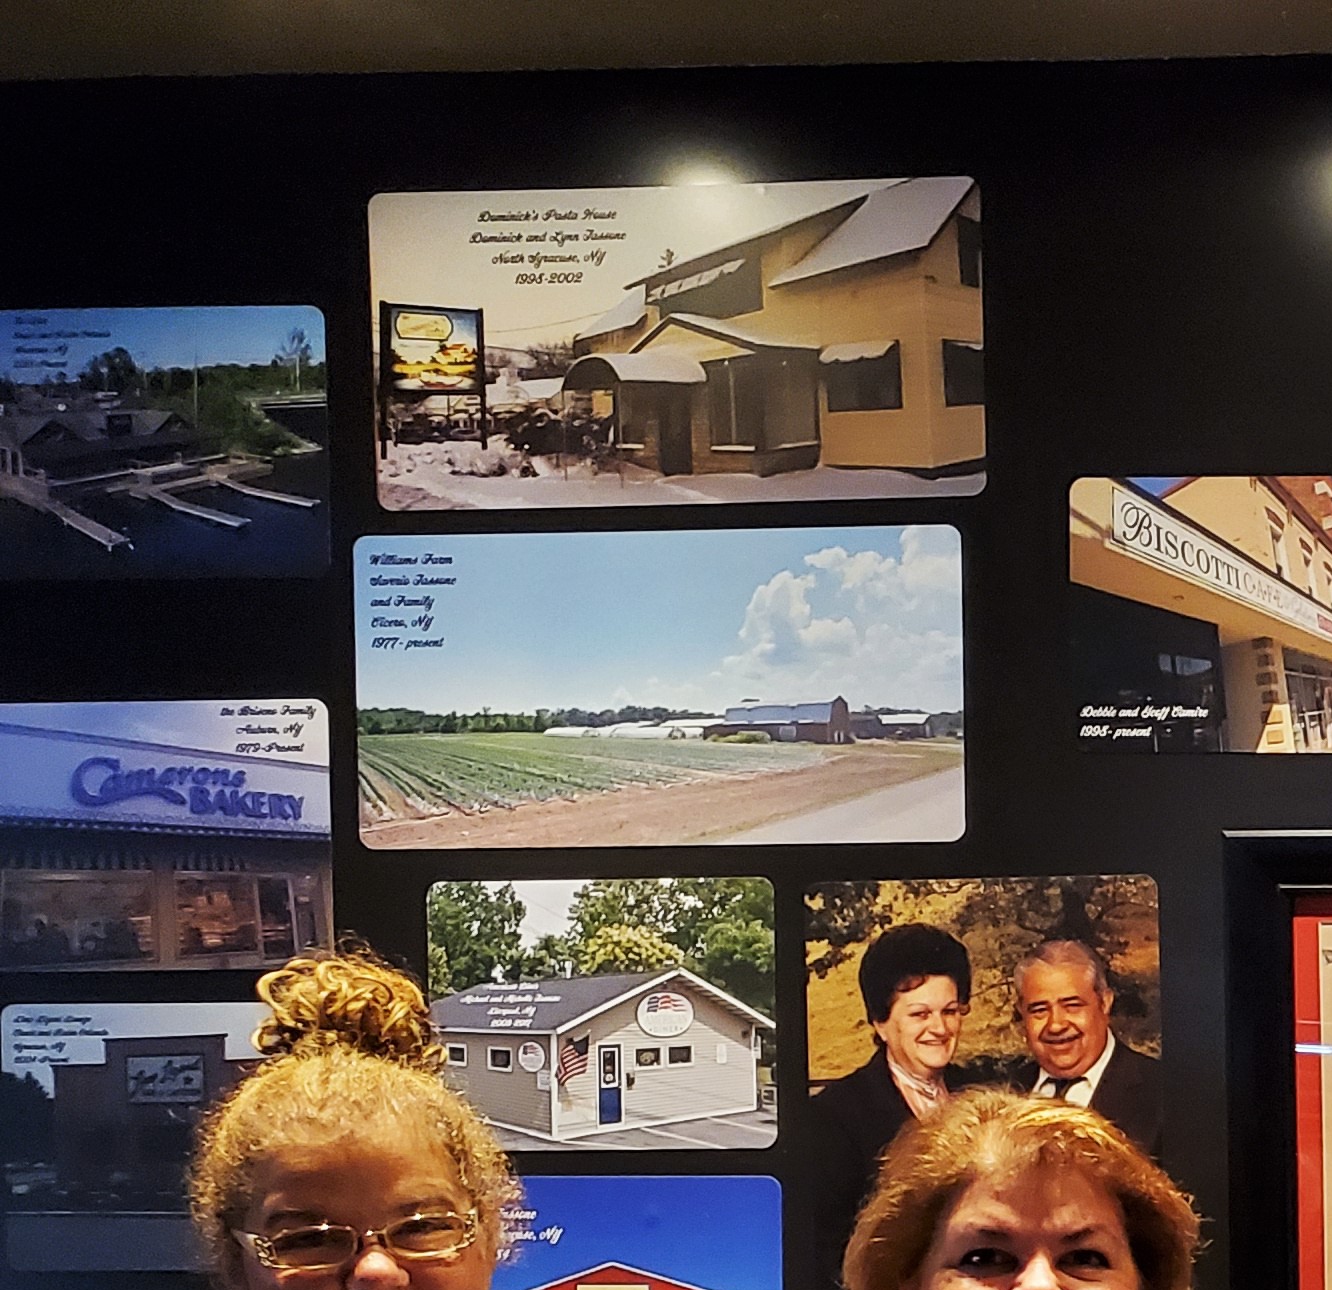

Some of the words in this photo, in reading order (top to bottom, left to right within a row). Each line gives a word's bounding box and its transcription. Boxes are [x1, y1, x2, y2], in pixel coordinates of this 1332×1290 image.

[478, 209, 539, 222] Dominick's
[542, 209, 578, 221] Pasta
[581, 208, 617, 220] House
[469, 231, 523, 243] Dominick
[526, 232, 547, 242] and
[549, 231, 579, 247] Lynn
[583, 229, 626, 241] Tassone
[492, 251, 524, 264] North
[528, 251, 580, 268] Syracuse,
[584, 248, 606, 266] NY
[1121, 501, 1241, 590] BISCOTTI
[370, 553, 418, 565] Williams
[421, 553, 453, 565] Farm
[370, 597, 392, 607] and
[394, 595, 435, 612] Family
[411, 614, 434, 631] NY
[404, 637, 444, 650] present
[280, 704, 316, 720] Family
[1080, 706, 1117, 717] Debbie
[1118, 706, 1140, 717] and
[1141, 705, 1170, 720] Geoff
[283, 722, 304, 738] NY
[1112, 726, 1152, 740] present
[71, 757, 246, 807] Camerons
[189, 785, 304, 821] BAKERY
[539, 1225, 563, 1244] NY
